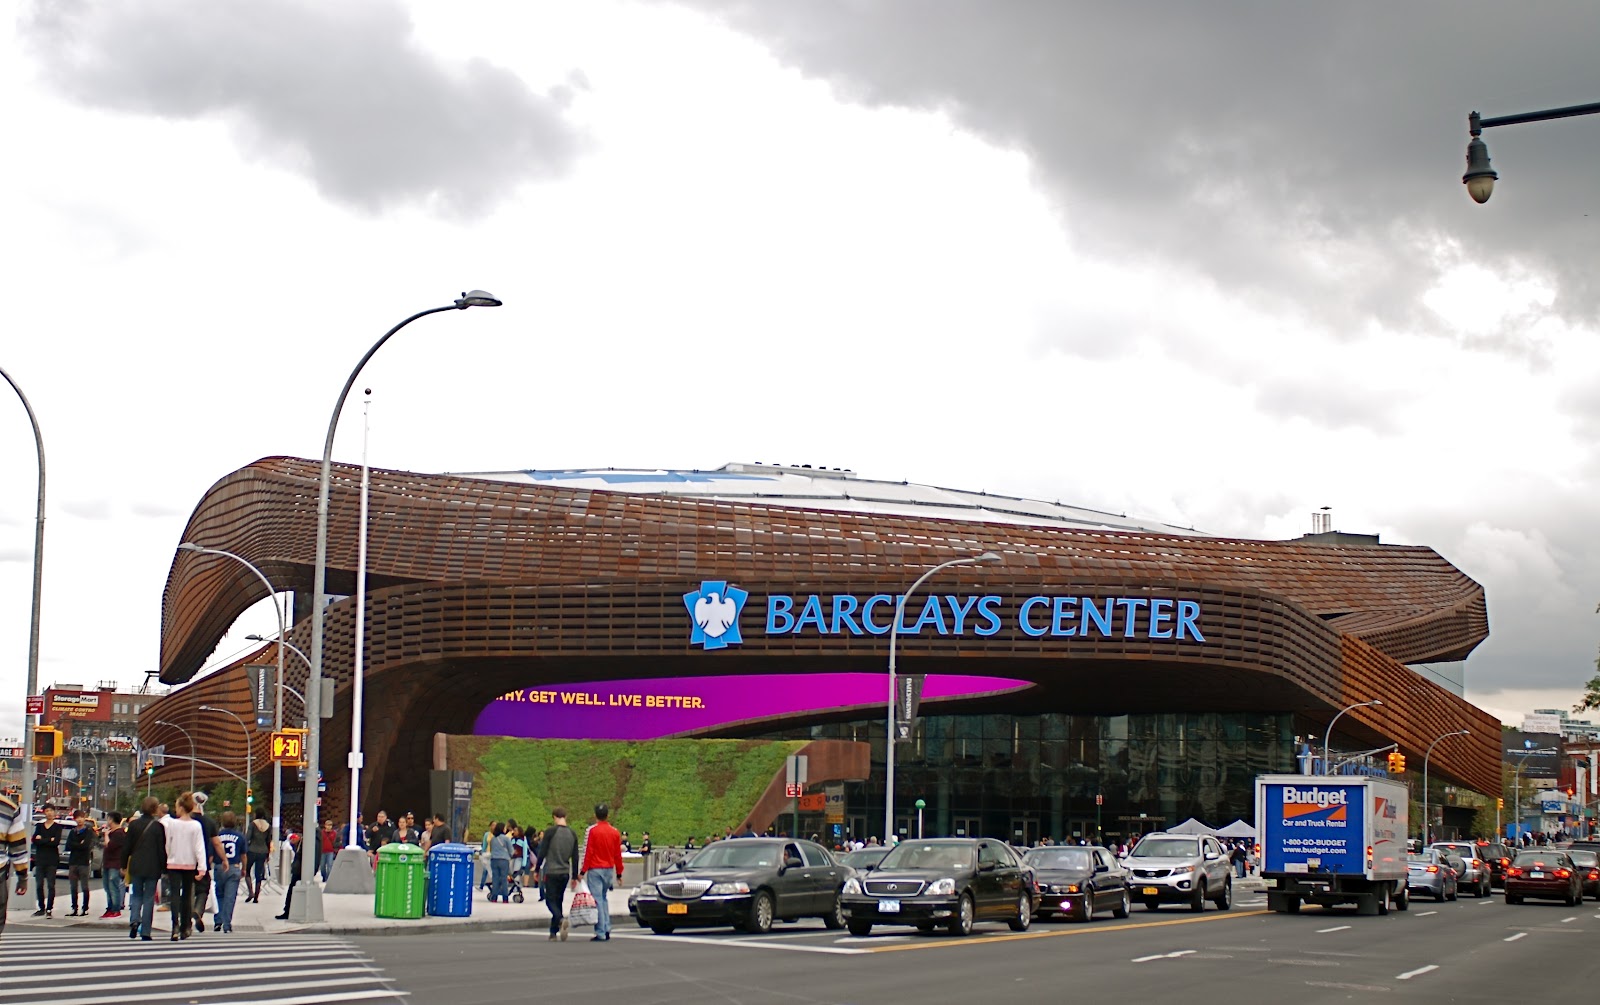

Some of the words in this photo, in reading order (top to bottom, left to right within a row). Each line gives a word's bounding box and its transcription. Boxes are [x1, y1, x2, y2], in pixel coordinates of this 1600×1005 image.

[765, 595, 1002, 635] BARCLAYS
[1018, 596, 1206, 642] CENTER
[496, 690, 526, 702] HY.
[529, 691, 557, 703] GET
[561, 692, 605, 706] WELL.
[610, 694, 642, 707] LIVE
[646, 695, 705, 709] BETTER.
[286, 739, 299, 757] 30
[1282, 786, 1347, 808] Budget
[1282, 819, 1294, 827] Car
[1295, 819, 1307, 827] and
[1326, 820, 1347, 828] Rental
[1282, 847, 1347, 855] www.budget.com
